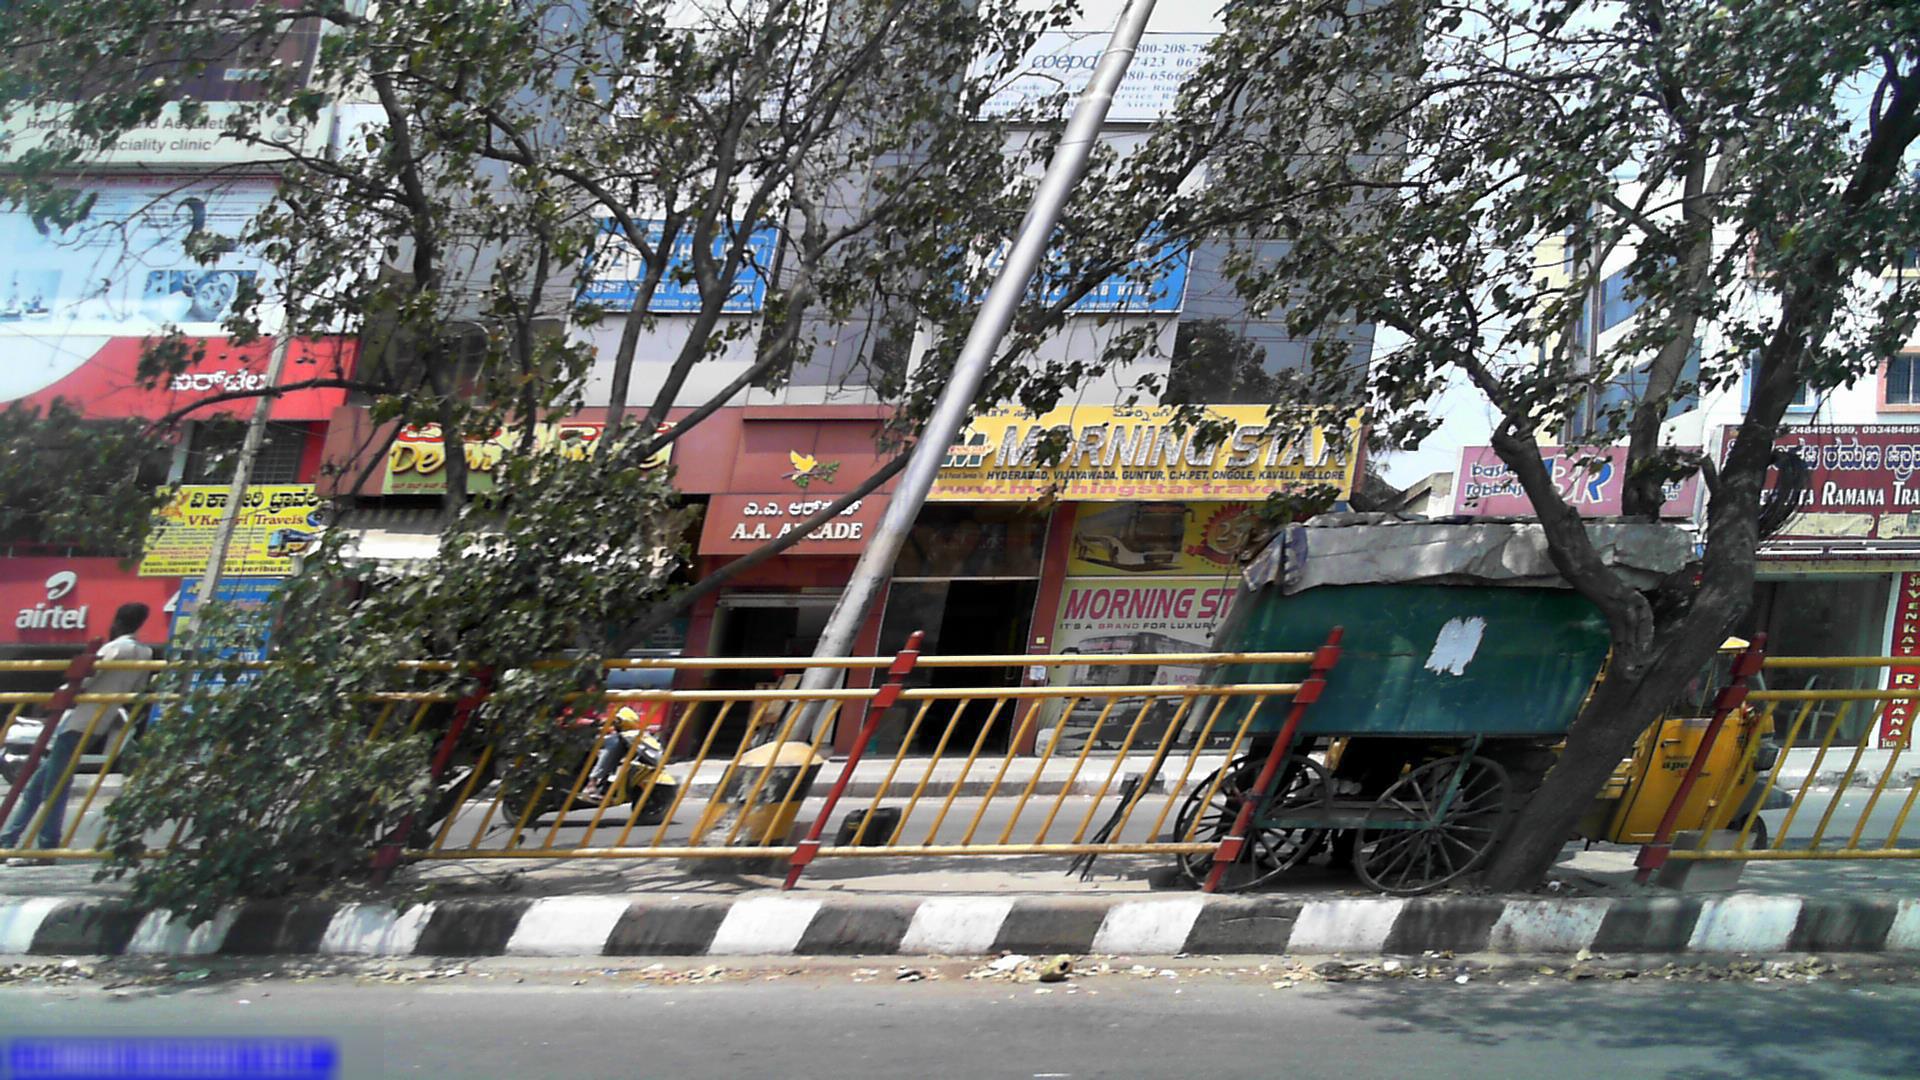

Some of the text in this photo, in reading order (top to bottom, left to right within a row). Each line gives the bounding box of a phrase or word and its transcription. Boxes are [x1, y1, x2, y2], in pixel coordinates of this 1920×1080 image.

[169, 138, 212, 151] clinic
[1053, 470, 1118, 480] VIJAYAWADA,
[1122, 470, 1166, 481] GUNTUR,
[1300, 470, 1345, 480] NELLORE
[1821, 481, 1884, 505] RAMANA
[254, 514, 304, 525] Travels
[730, 522, 863, 539] A.A. ACADE
[1063, 588, 1196, 619] MORNING
[15, 603, 88, 630] airtel
[1142, 622, 1166, 630] FOR
[1887, 673, 1916, 736] RMANA
